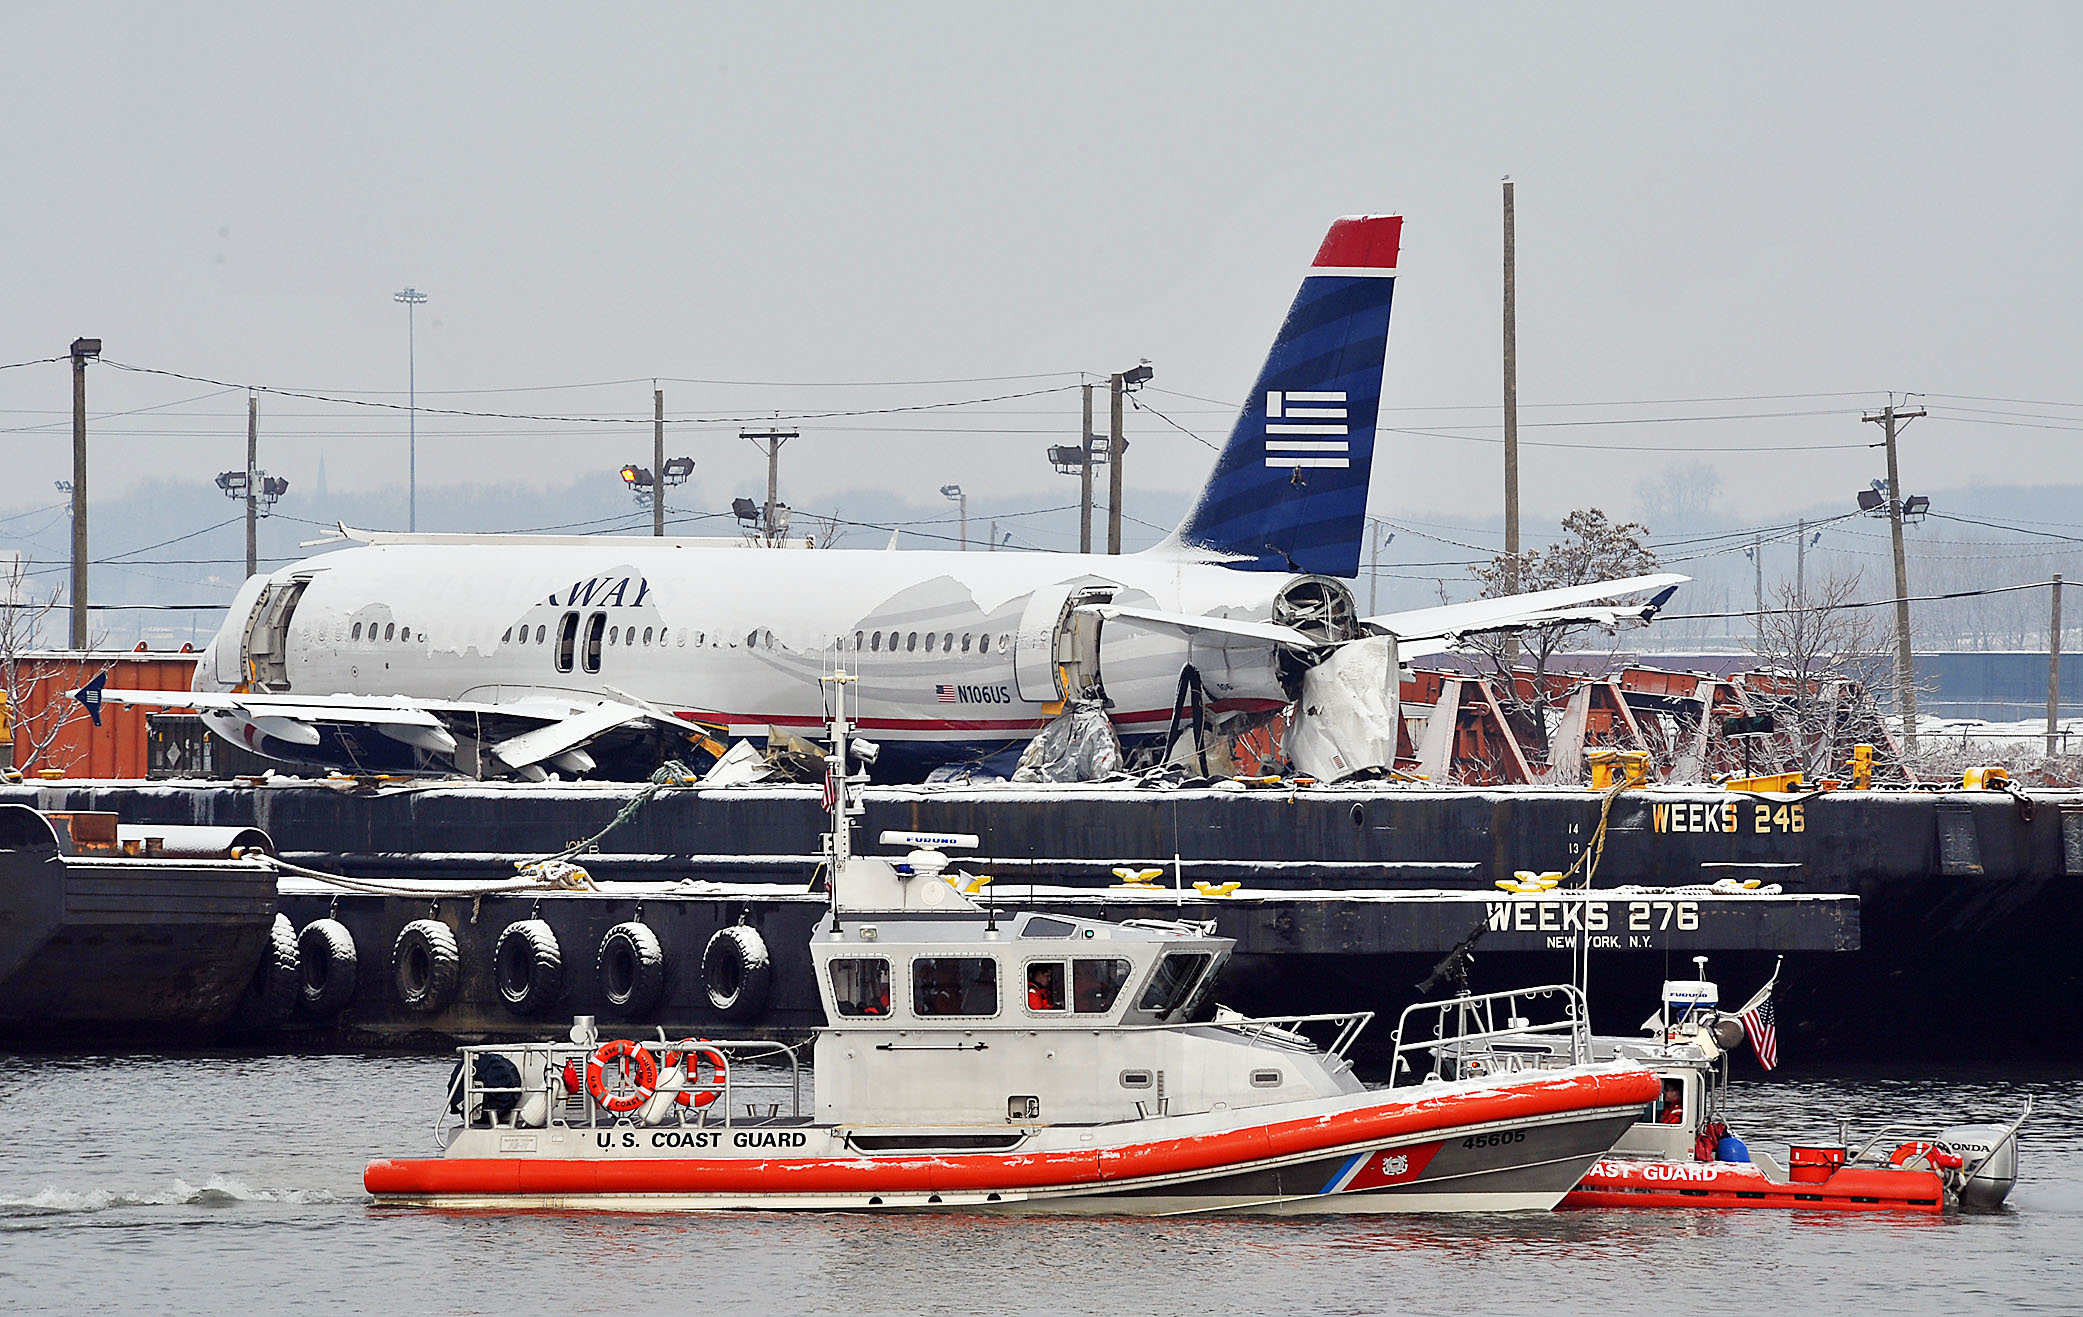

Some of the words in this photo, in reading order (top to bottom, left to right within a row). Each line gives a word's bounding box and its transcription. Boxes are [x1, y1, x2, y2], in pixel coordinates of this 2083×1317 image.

[957, 685, 1011, 704] N106US
[1652, 803, 1738, 833] WEEKS
[1755, 804, 1805, 833] 246
[1568, 823, 1579, 834] 14
[906, 836, 957, 844] FURUNO
[1568, 842, 1579, 854] 13
[1486, 902, 1609, 931] WEEKS
[1628, 902, 1699, 931] 276
[1547, 936, 1575, 948] NEW
[1629, 936, 1653, 948] N.Y.
[651, 1132, 722, 1148] COAST
[733, 1132, 806, 1148] GUARD
[1462, 1130, 1526, 1150] 45605
[1949, 1142, 1991, 1153] ONDA
[1643, 1167, 1718, 1181] GUARD
